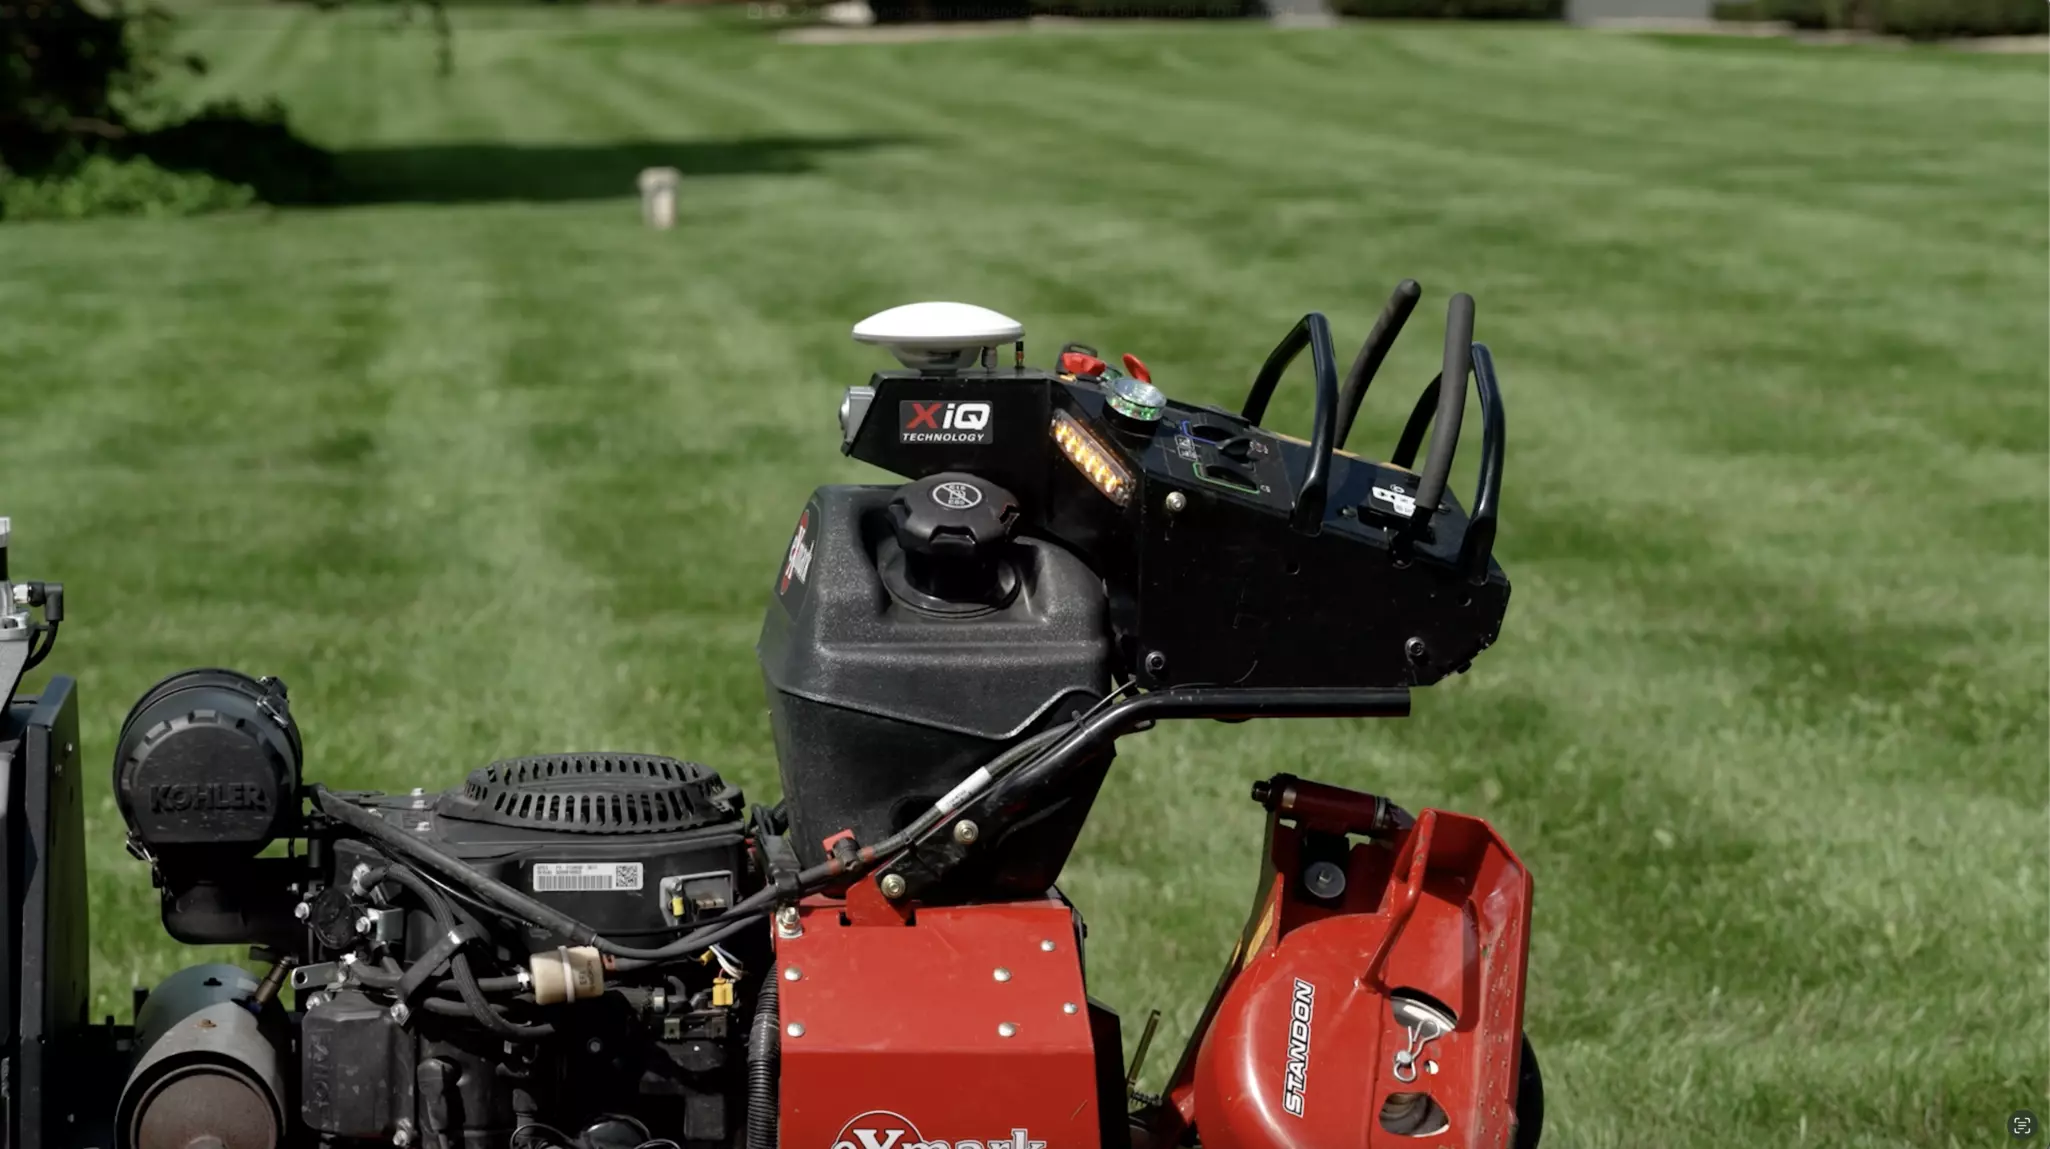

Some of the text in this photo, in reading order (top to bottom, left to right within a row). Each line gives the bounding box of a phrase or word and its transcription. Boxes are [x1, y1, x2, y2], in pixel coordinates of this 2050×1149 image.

[902, 433, 985, 442] TECHNOLOGY
[150, 783, 270, 814] KOHLER
[1283, 977, 1315, 1118] STANDON
